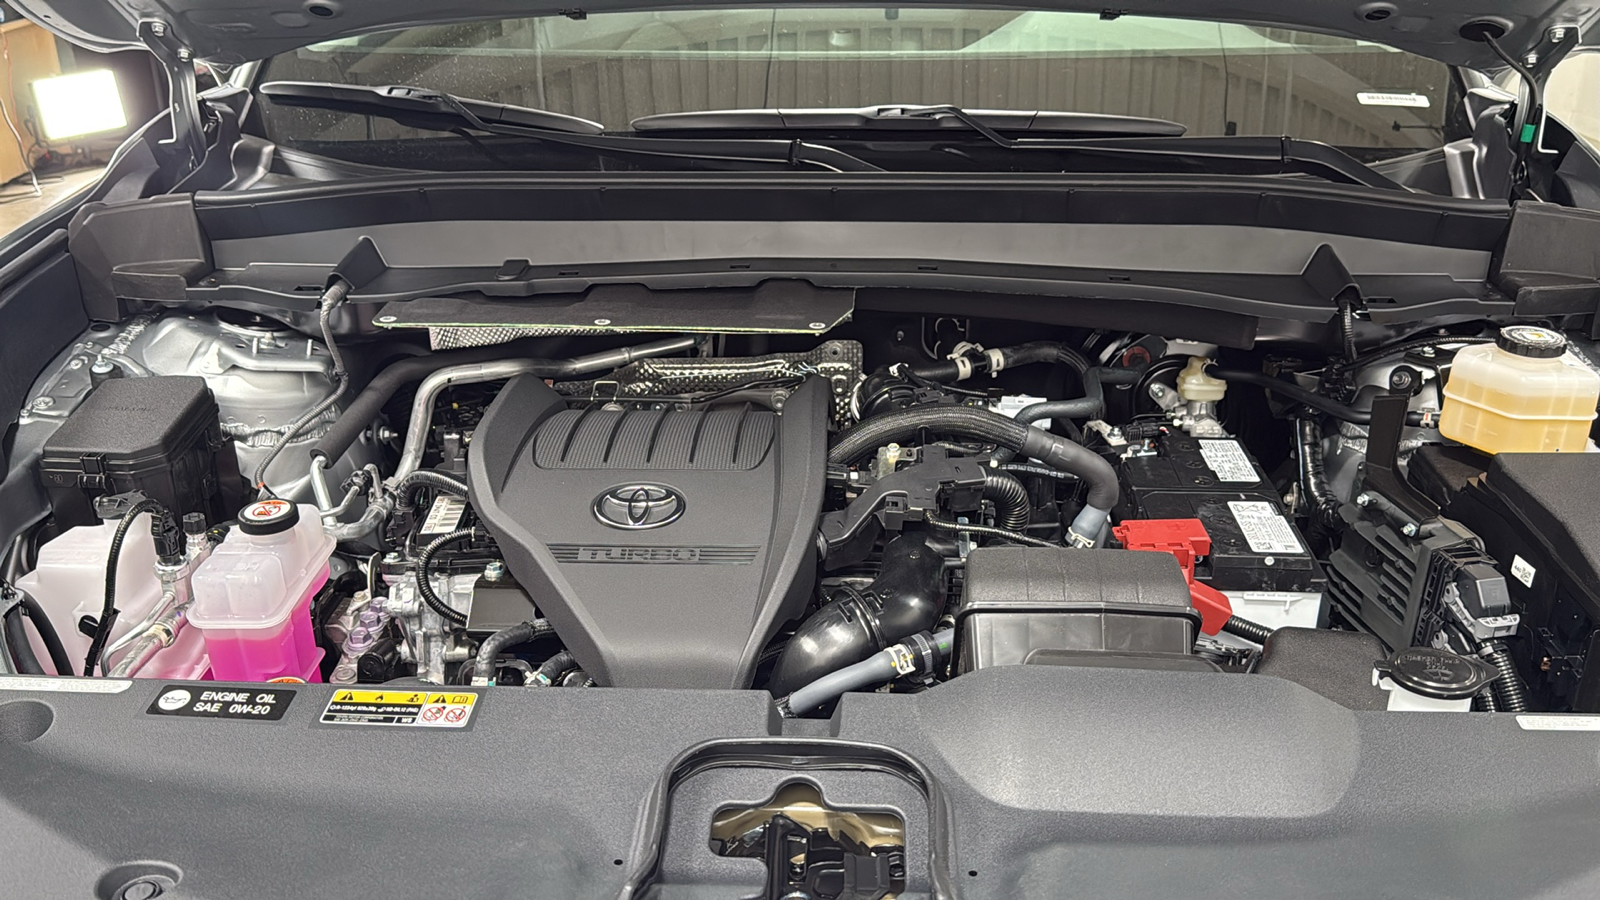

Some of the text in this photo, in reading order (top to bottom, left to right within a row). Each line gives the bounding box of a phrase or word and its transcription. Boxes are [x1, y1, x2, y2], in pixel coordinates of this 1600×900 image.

[581, 547, 697, 561] TURBO
[200, 690, 277, 704] ENGINE OIL
[193, 702, 271, 715] SAE 0W-20
